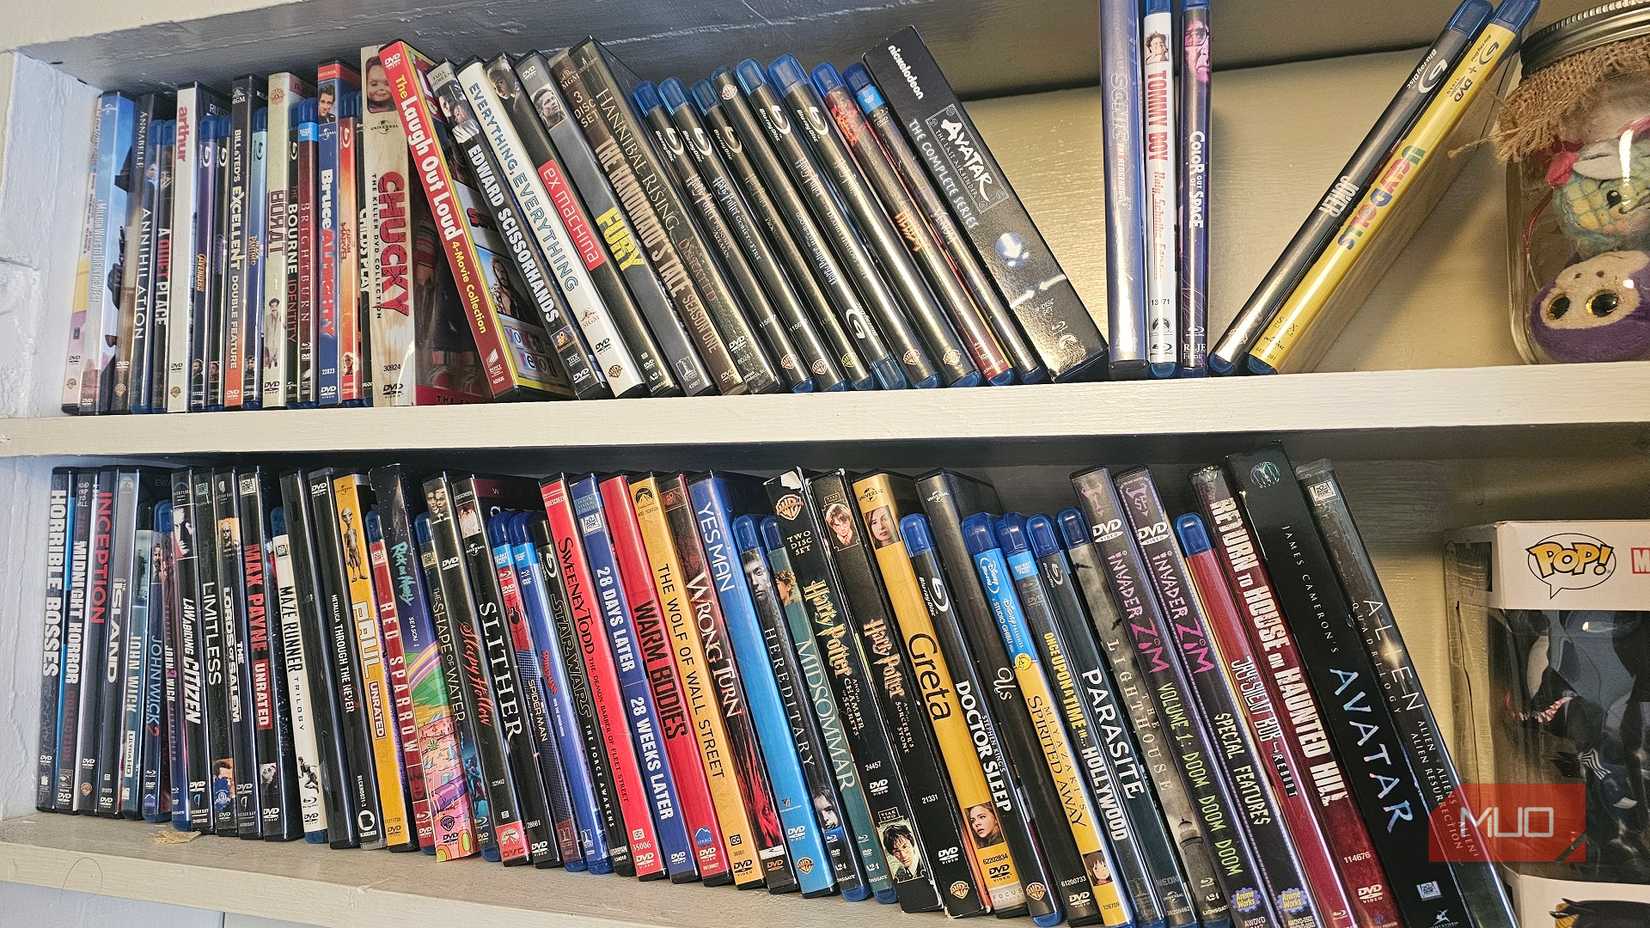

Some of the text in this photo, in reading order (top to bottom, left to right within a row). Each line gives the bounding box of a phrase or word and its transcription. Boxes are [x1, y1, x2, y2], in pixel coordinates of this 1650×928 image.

[573, 91, 584, 104] 3
[574, 98, 597, 120] DISC
[581, 109, 600, 128] SET
[887, 44, 924, 100] nickelodeon
[1147, 70, 1168, 161] TOMMY BOY
[177, 106, 189, 162] arthur
[595, 87, 681, 233] HANNIBAL RISING
[909, 119, 980, 229] THE COMPLETE SERIES
[940, 118, 993, 203] AVATAR
[321, 169, 334, 229] Bruce
[372, 171, 410, 317] CHUCKY
[395, 76, 487, 334] The Laugh Out Loud 4-Movie Collection
[467, 144, 561, 323] EDWARD SCISSORHANDS
[512, 172, 579, 293] EVERYTHING
[543, 166, 600, 265] ex machina
[595, 206, 646, 272] FURY
[1319, 174, 1361, 218] JOKER
[134, 208, 151, 339] ANNIHILATION
[155, 282, 169, 326] PLACE
[230, 186, 244, 369] EXCELLENT DOUBLE FEATURE
[287, 203, 299, 343] BOURNE IDENTITY
[299, 202, 310, 322] BRIGHTBURN
[657, 258, 694, 299] TALE
[682, 294, 706, 332] SEASON
[702, 330, 720, 355] ONE
[43, 489, 67, 677] HORRIBLE BOSSES
[69, 540, 88, 619] MIDNIGHT
[89, 491, 113, 624] INCEPTION
[698, 501, 736, 593] YES MAN
[786, 529, 812, 544] TWO
[791, 537, 813, 550] DISC
[795, 546, 812, 556] SET
[1137, 521, 1169, 541] DVD
[1525, 541, 1615, 578] POP!
[202, 581, 222, 686] LIMITLESS
[244, 543, 271, 727] MAX PAYNE UNRATED
[351, 601, 381, 679] PAUL
[558, 536, 586, 612] SWEENEY
[577, 607, 595, 655] TODD
[596, 566, 636, 673] 28 DAYS LATER
[803, 578, 853, 679] Harry Potter
[1280, 525, 1341, 655] JAMES CAMERON'S
[65, 622, 83, 684] HORROR
[127, 633, 142, 713] JOHN WICK
[183, 656, 201, 725] CITIZEN
[279, 586, 305, 731] MAZE RUNNER TRILOGY
[334, 623, 348, 666] THROUGH
[339, 665, 351, 684] THE
[380, 601, 419, 752] RED SPARROW
[431, 601, 466, 722] SHAPE WATER
[479, 601, 523, 742] SLITHER
[633, 599, 689, 741] WARM BODIES
[657, 562, 726, 779] THE WOLF OF WALL STREET
[686, 571, 742, 718] WRONG TURN
[763, 626, 815, 767] HEREDITARY
[863, 618, 905, 700] Harry Potter
[907, 631, 952, 721] Greta
[992, 666, 1018, 701] Us
[1209, 496, 1350, 808] RETURN TO HOUSE ON HAUNTED HILL
[1362, 598, 1426, 713] ALIEN
[343, 684, 355, 713] NEVER
[369, 682, 386, 738] UNRATED
[470, 673, 492, 728] Hollow
[565, 649, 615, 828] WARS FORCE AWAKENS
[797, 638, 856, 791] MIDSOMMAR
[954, 679, 1012, 813] DOCTOR SLEEP
[1043, 632, 1129, 842] ONCE UPON TIME HOLLYWOOD
[1082, 666, 1145, 800] PARASITE
[1106, 638, 1174, 791] LIGHTHOUSE
[1328, 667, 1415, 835] AVATAR
[1417, 720, 1436, 752] ALIEN
[630, 697, 675, 820] 28 WEEKS LATER
[1027, 695, 1088, 828] SPIRITED AWAY
[1156, 681, 1244, 877] VOLUME DOOM DOOM DOOM
[1214, 712, 1272, 826] SPECIAL FEATURES
[1409, 733, 1464, 852] ALIEN RESURRECTION
[1343, 851, 1371, 865] 114676
[1358, 884, 1383, 898] DVD
